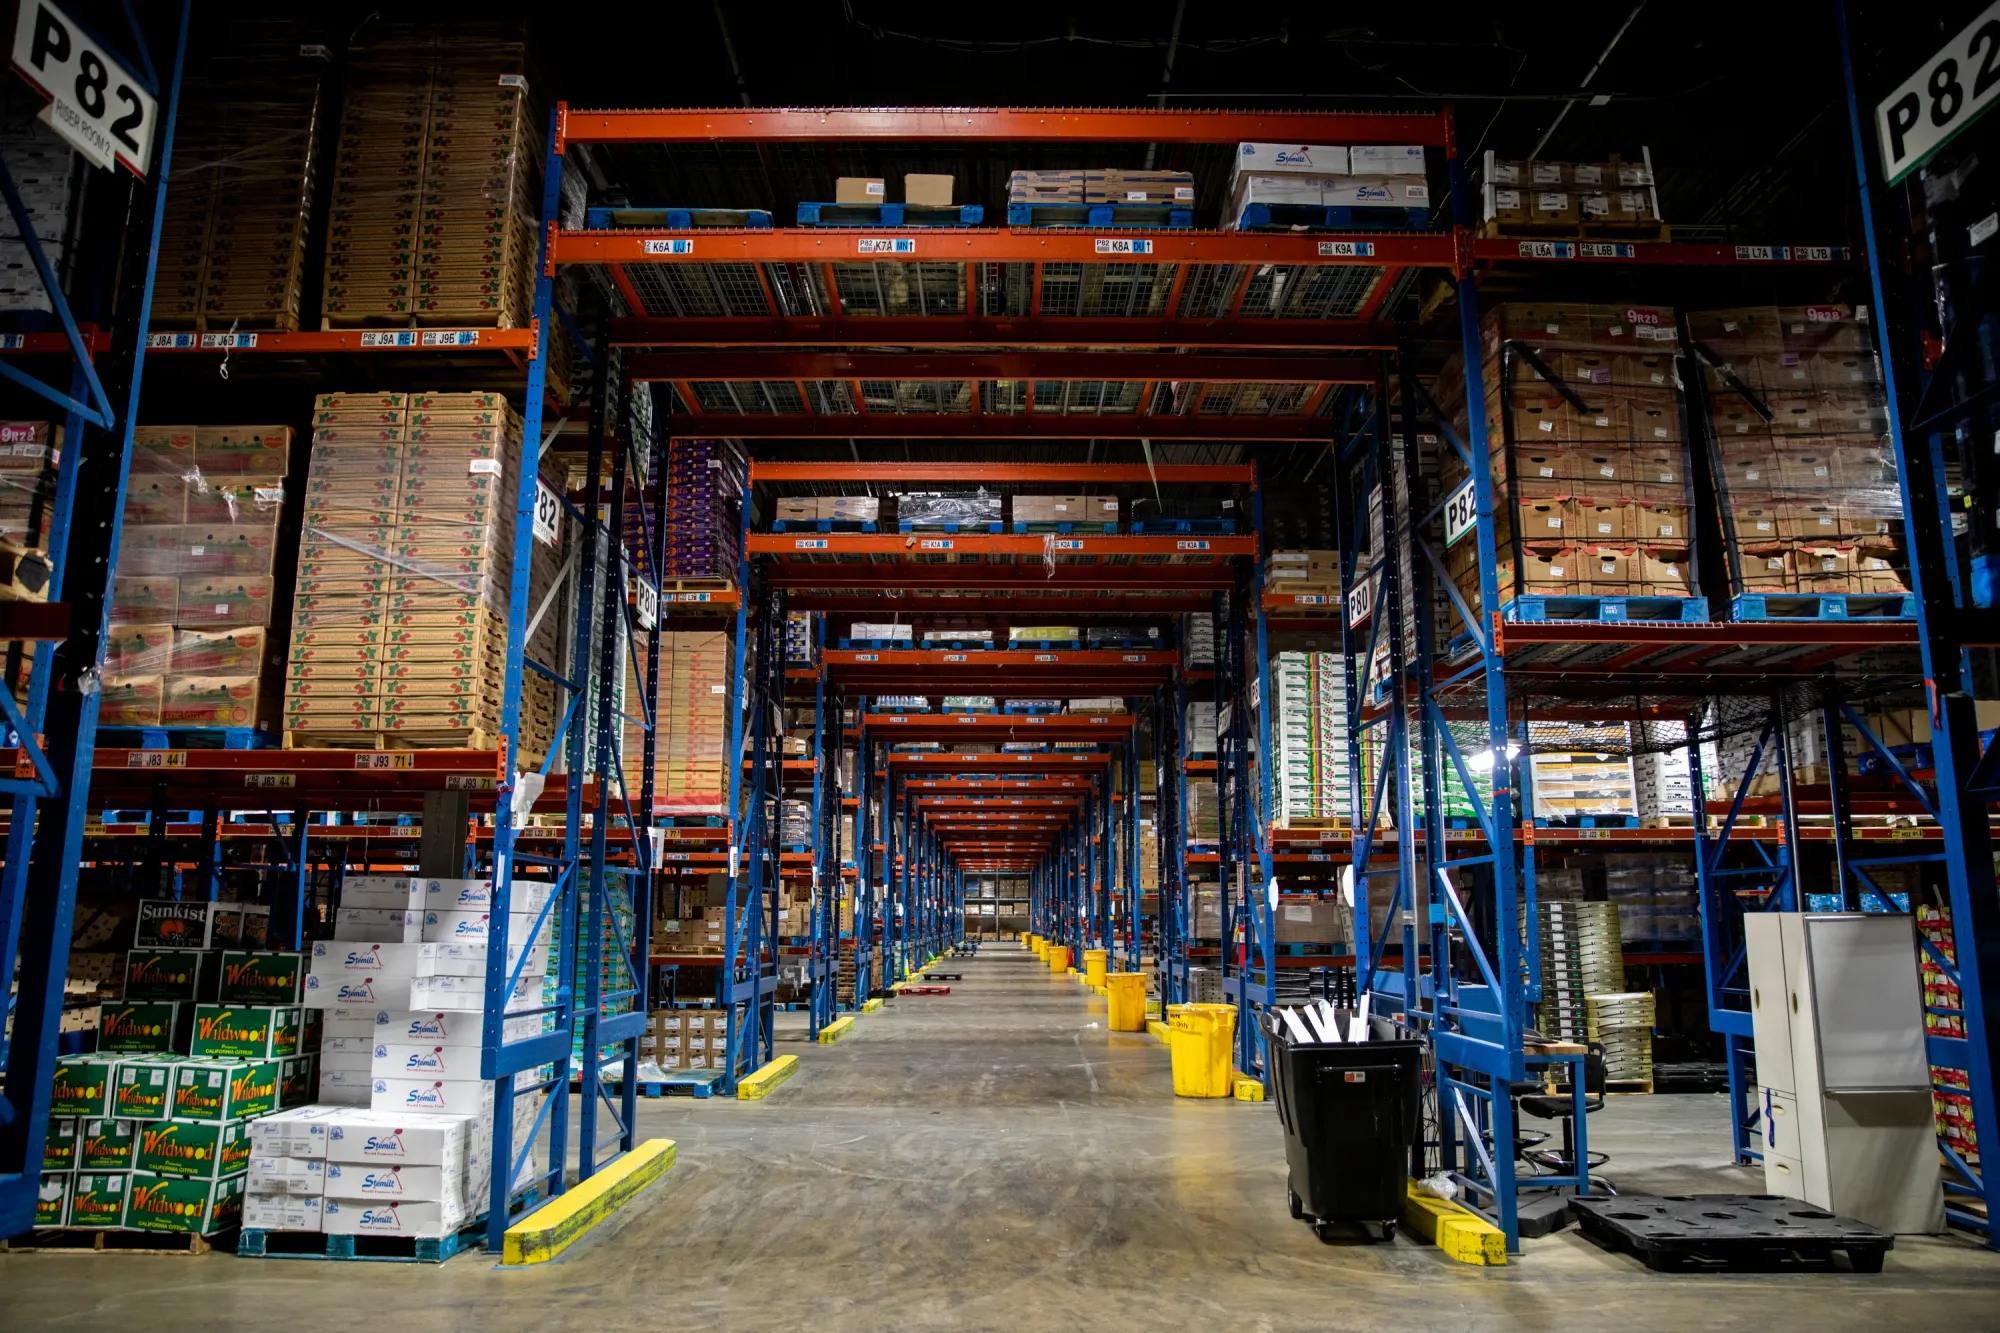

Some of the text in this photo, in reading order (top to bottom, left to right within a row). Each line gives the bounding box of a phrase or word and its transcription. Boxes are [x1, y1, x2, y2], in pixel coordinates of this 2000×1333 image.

[30, 3, 144, 156] P82
[1887, 19, 2000, 164] P82
[56, 99, 110, 157] RISER ROOM 2
[1276, 152, 1304, 164] Stemilt
[1357, 186, 1386, 198] Stemilt
[654, 242, 669, 252] K6A
[675, 242, 684, 252] UJ
[876, 241, 892, 251] K7A
[1112, 241, 1129, 251] K8A
[1336, 244, 1352, 254] K9A
[1597, 246, 1612, 256] L6B
[1752, 248, 1768, 258] L7A
[1811, 249, 1827, 258] L7B
[1627, 310, 1658, 324] 9R28
[1807, 308, 1839, 321] 9R28
[156, 336, 172, 346] J8A
[378, 334, 394, 344] J9A
[536, 486, 556, 530] 82
[1449, 485, 1476, 536] P82
[640, 582, 655, 618] P80
[1350, 590, 1368, 621] P80
[147, 755, 161, 766] J83
[167, 755, 178, 765] 44
[374, 756, 388, 768] J93
[395, 756, 405, 767] 71
[262, 777, 275, 787] J83
[280, 777, 289, 786] 44
[464, 779, 476, 788] J93
[482, 778, 490, 788] 71
[458, 890, 486, 902] Stemilt
[142, 904, 206, 922] Sunkist
[456, 922, 484, 933] Stemilt
[345, 953, 374, 966] Stemilt
[130, 956, 193, 984] Wildwood
[226, 958, 295, 987] Wildwood
[338, 986, 367, 999] Stemilt
[103, 1008, 169, 1037] Wildwood
[198, 1011, 266, 1042] Wildwood
[408, 1021, 438, 1034] Stemilt
[407, 1054, 436, 1068] Stemilt
[232, 1069, 276, 1104] Wildwood
[118, 1084, 164, 1105] Wildwood
[176, 1085, 222, 1108] Wildwood
[406, 1090, 436, 1103] Stemilt
[85, 1136, 132, 1155] Wildwood
[143, 1126, 214, 1160] Wildwood
[364, 1137, 396, 1151] Stemilt
[362, 1174, 394, 1189] Stemilt
[75, 1191, 121, 1212] Wildwood
[133, 1181, 203, 1217] Wildwood
[360, 1210, 392, 1225] Stemilt
